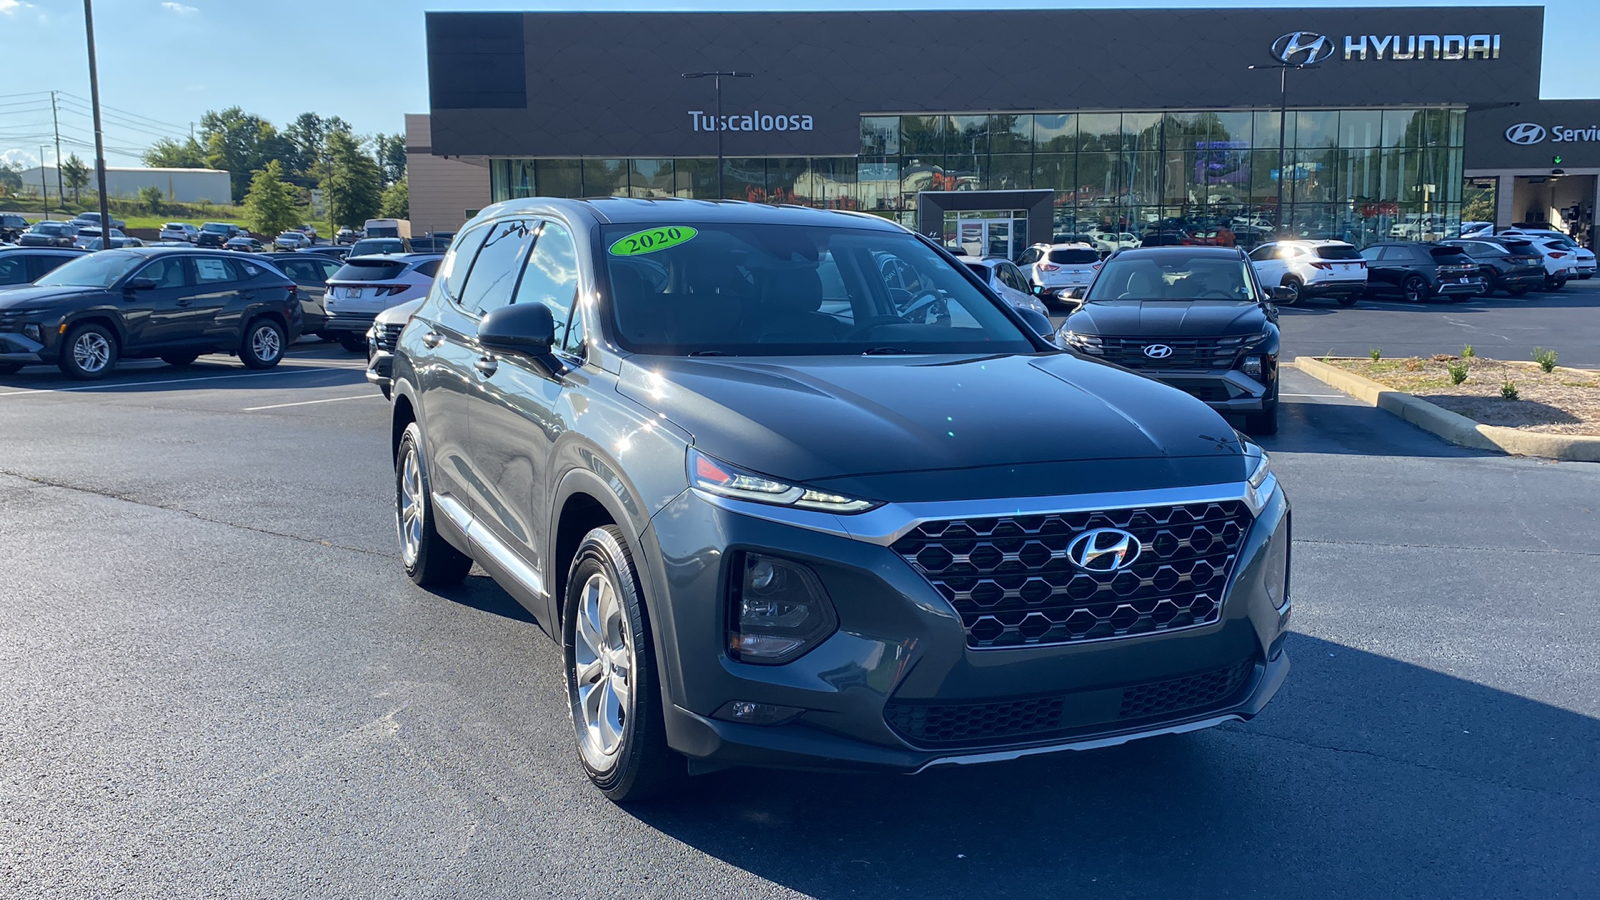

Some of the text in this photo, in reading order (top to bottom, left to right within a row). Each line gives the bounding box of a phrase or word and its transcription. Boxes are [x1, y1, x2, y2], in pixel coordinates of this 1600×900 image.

[1344, 34, 1500, 60] HYUNDAI
[688, 110, 813, 131] Tuscaloosa
[625, 228, 681, 253] 2020
